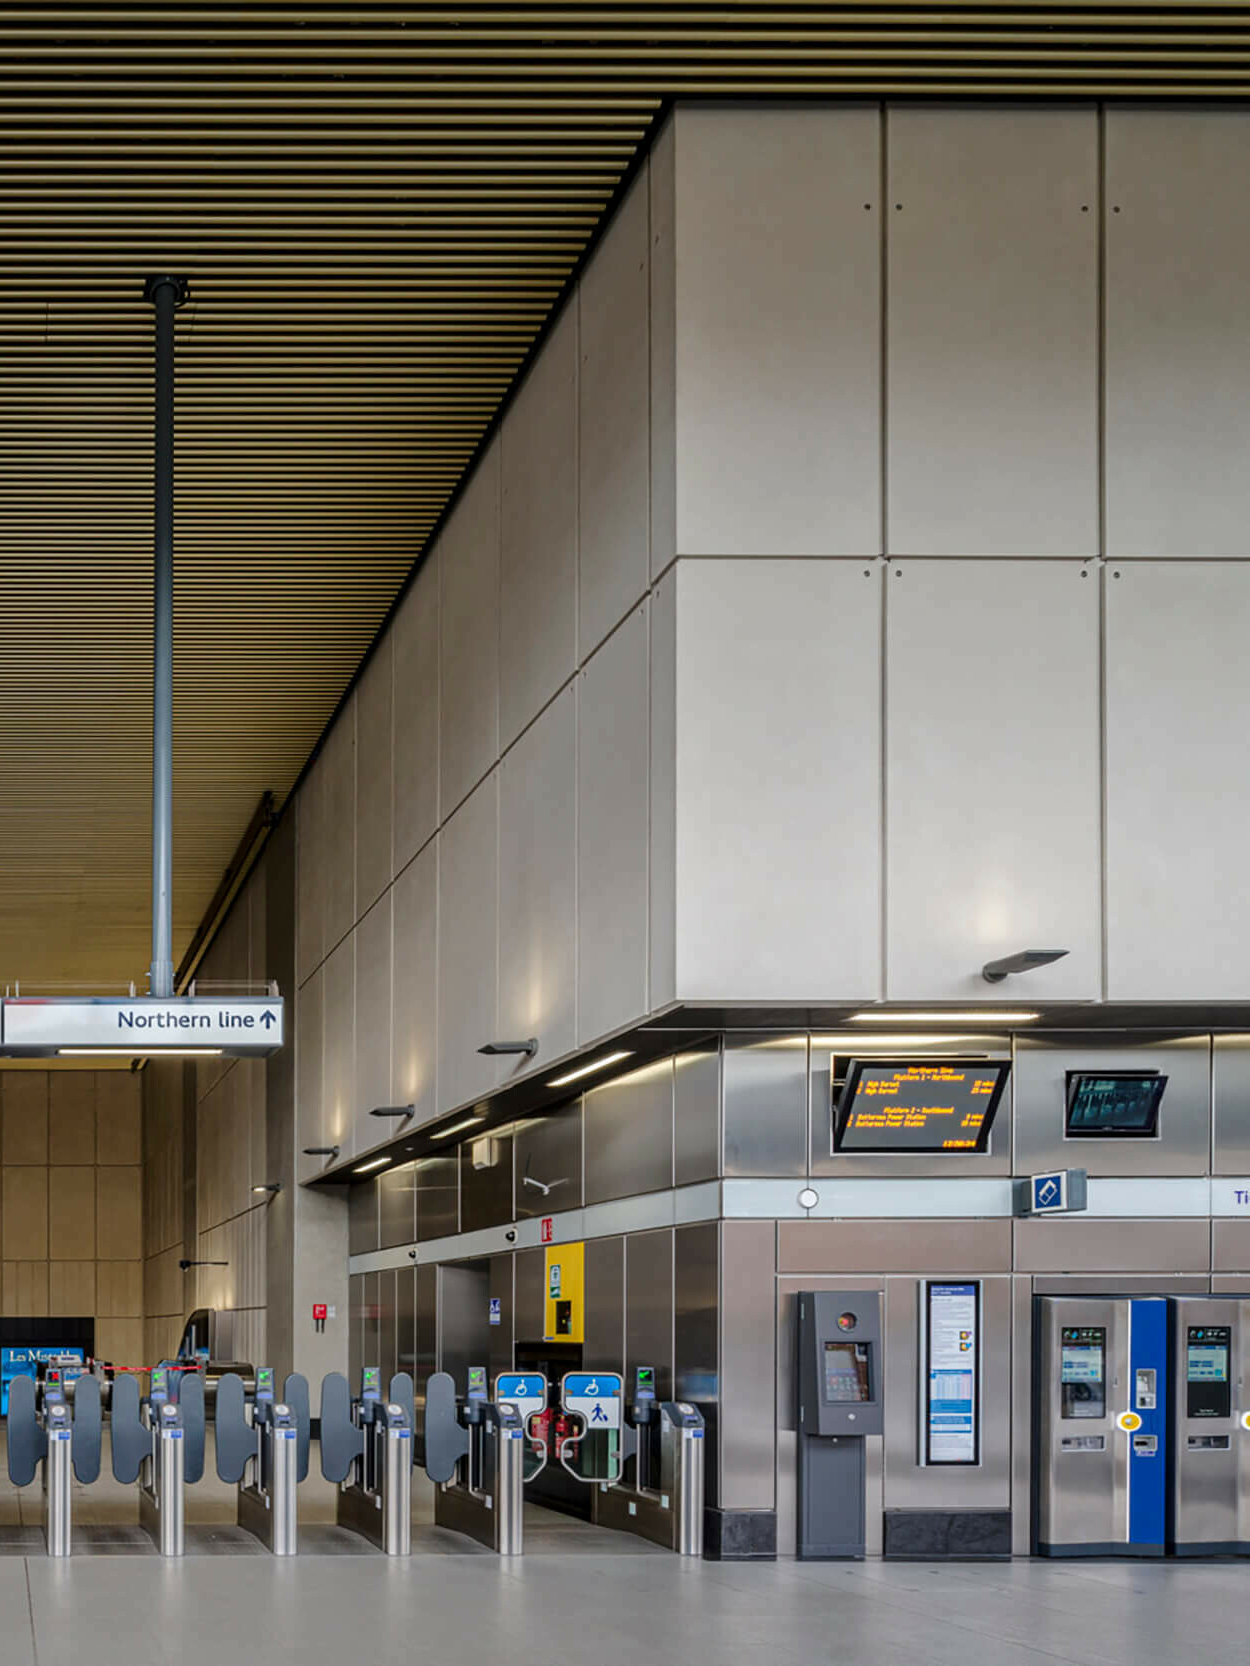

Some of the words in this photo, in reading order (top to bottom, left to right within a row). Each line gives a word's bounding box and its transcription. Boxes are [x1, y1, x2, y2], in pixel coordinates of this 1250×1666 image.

[118, 1011, 211, 1028] Northern
[218, 1011, 255, 1028] line
[10, 1350, 26, 1362] Les
